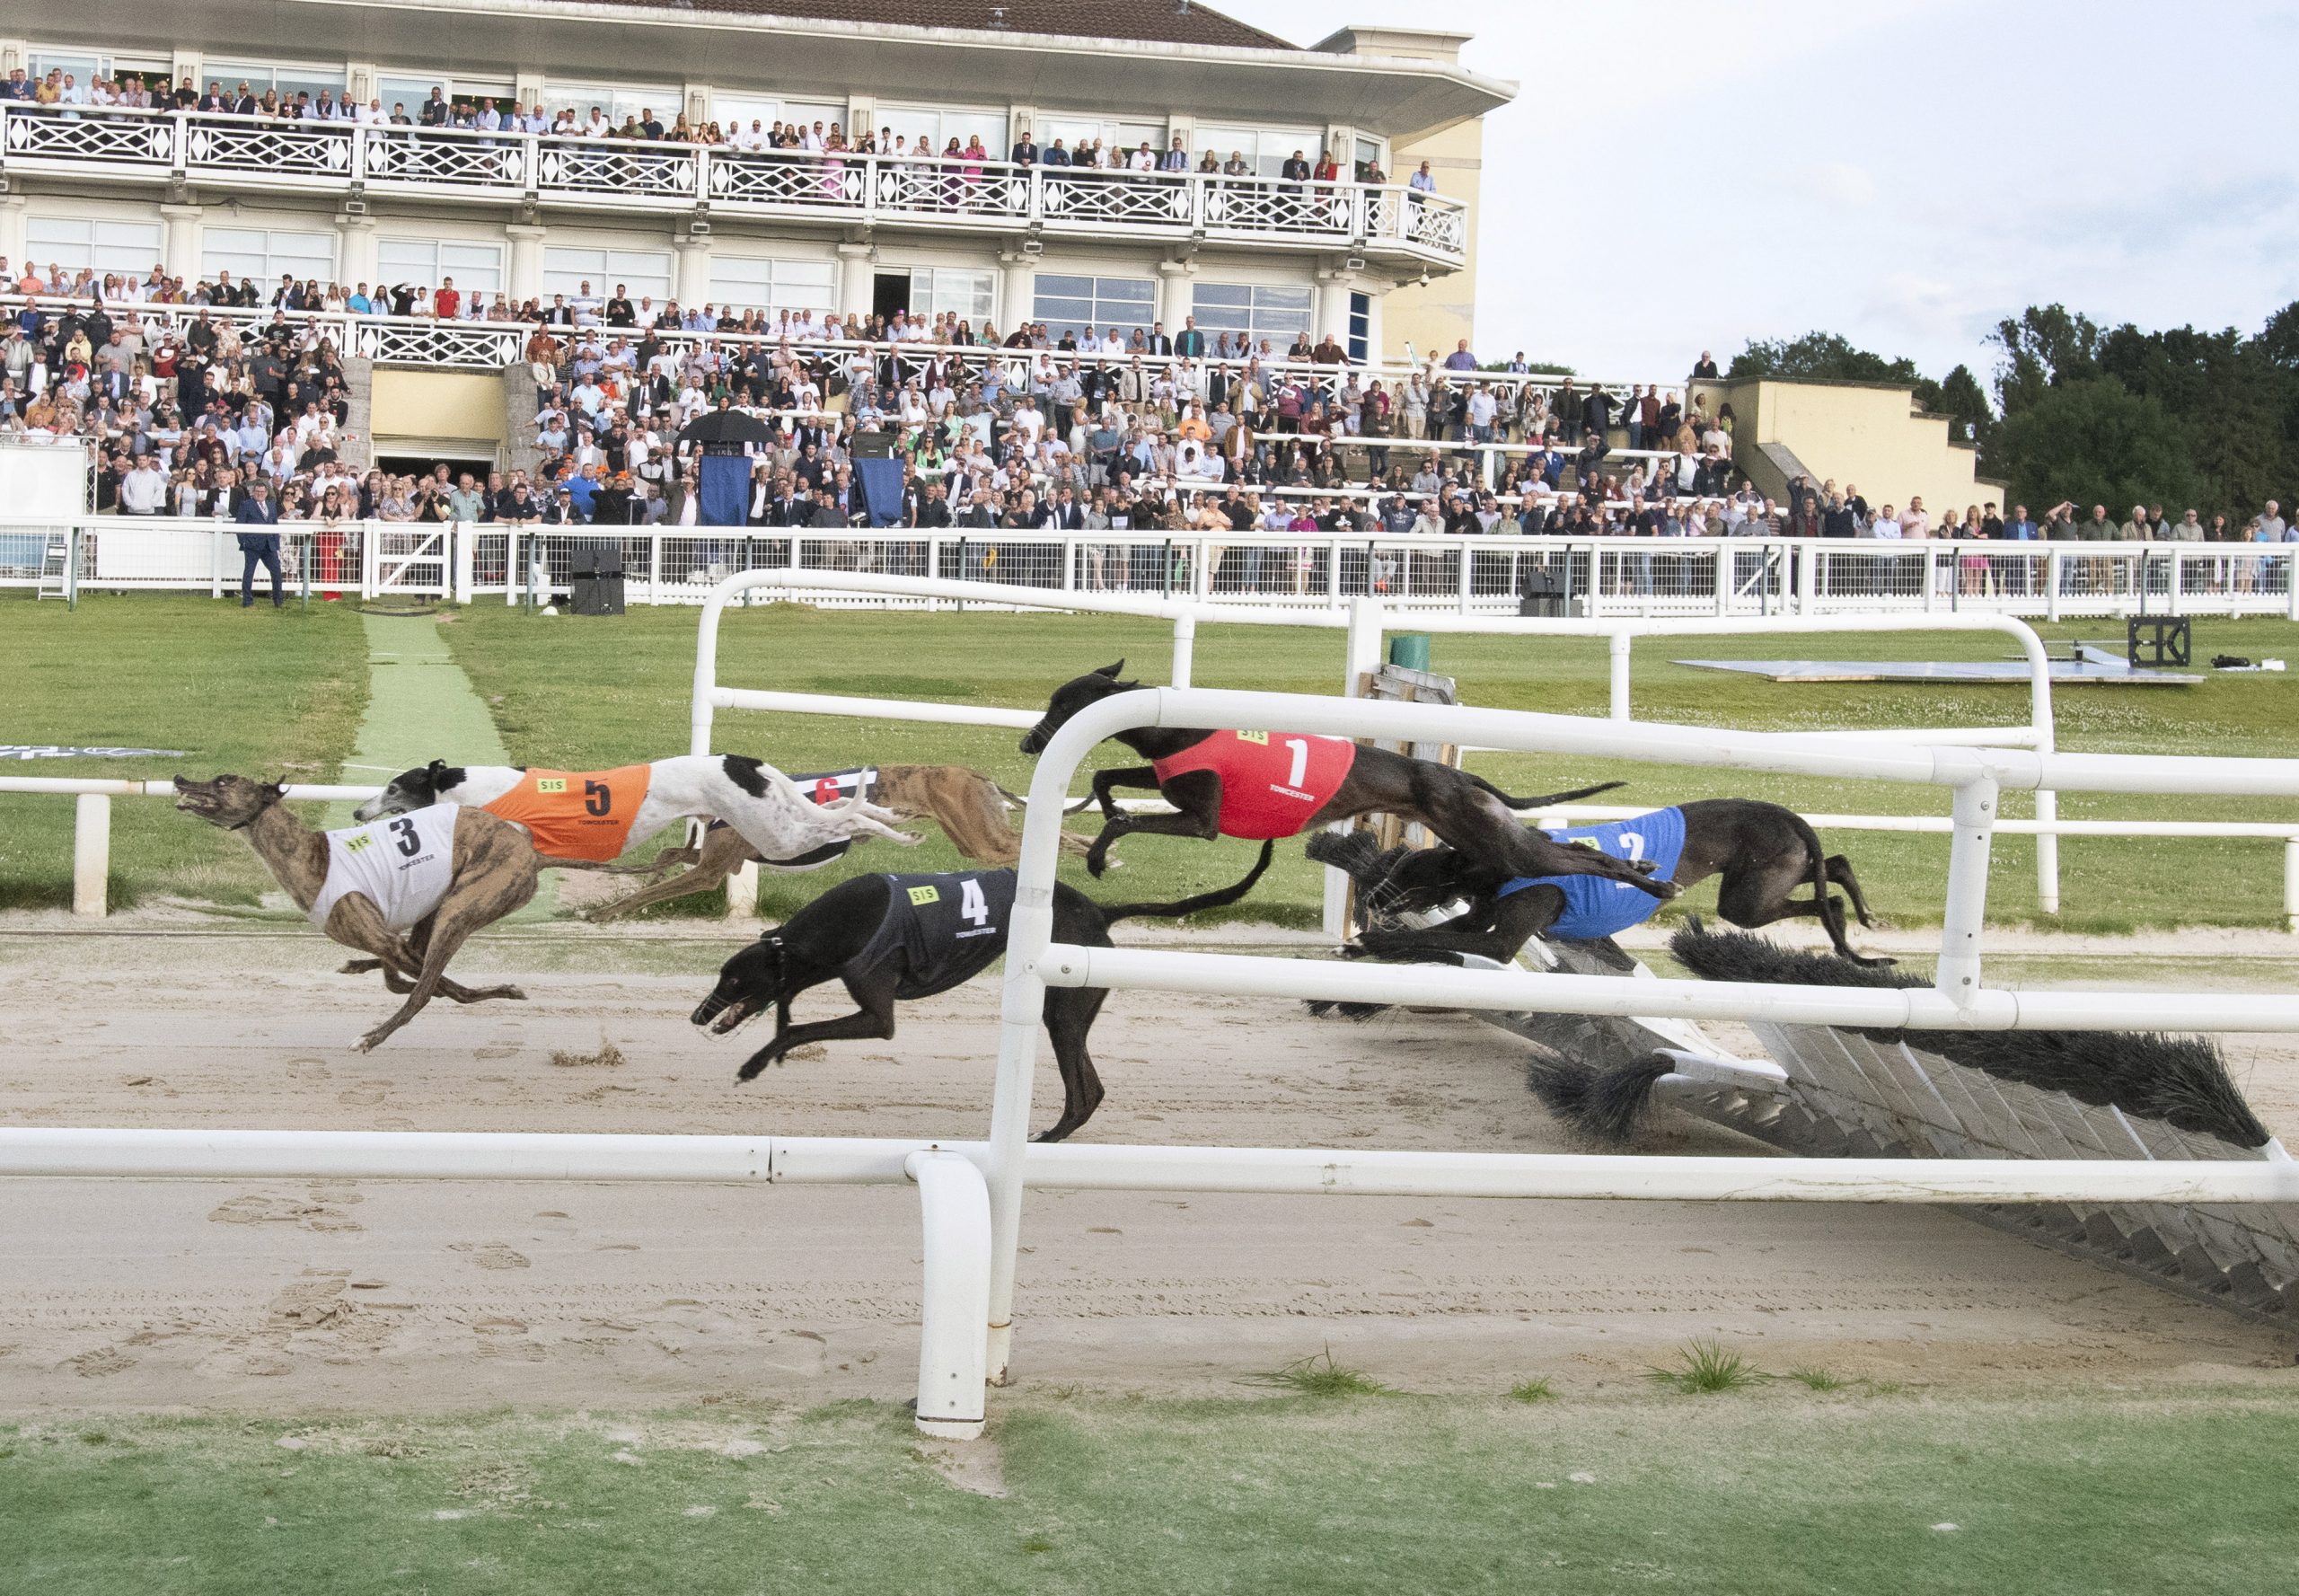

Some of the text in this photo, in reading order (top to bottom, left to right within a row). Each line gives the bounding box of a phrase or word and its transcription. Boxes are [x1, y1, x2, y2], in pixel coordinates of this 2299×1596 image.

[1285, 738, 1308, 789] 1
[541, 780, 563, 790] SIS
[585, 779, 611, 817] 5
[815, 777, 841, 807] 6
[348, 835, 369, 851] SIS
[389, 817, 421, 858] 3
[912, 888, 934, 901] SIS
[960, 877, 989, 926] 4
